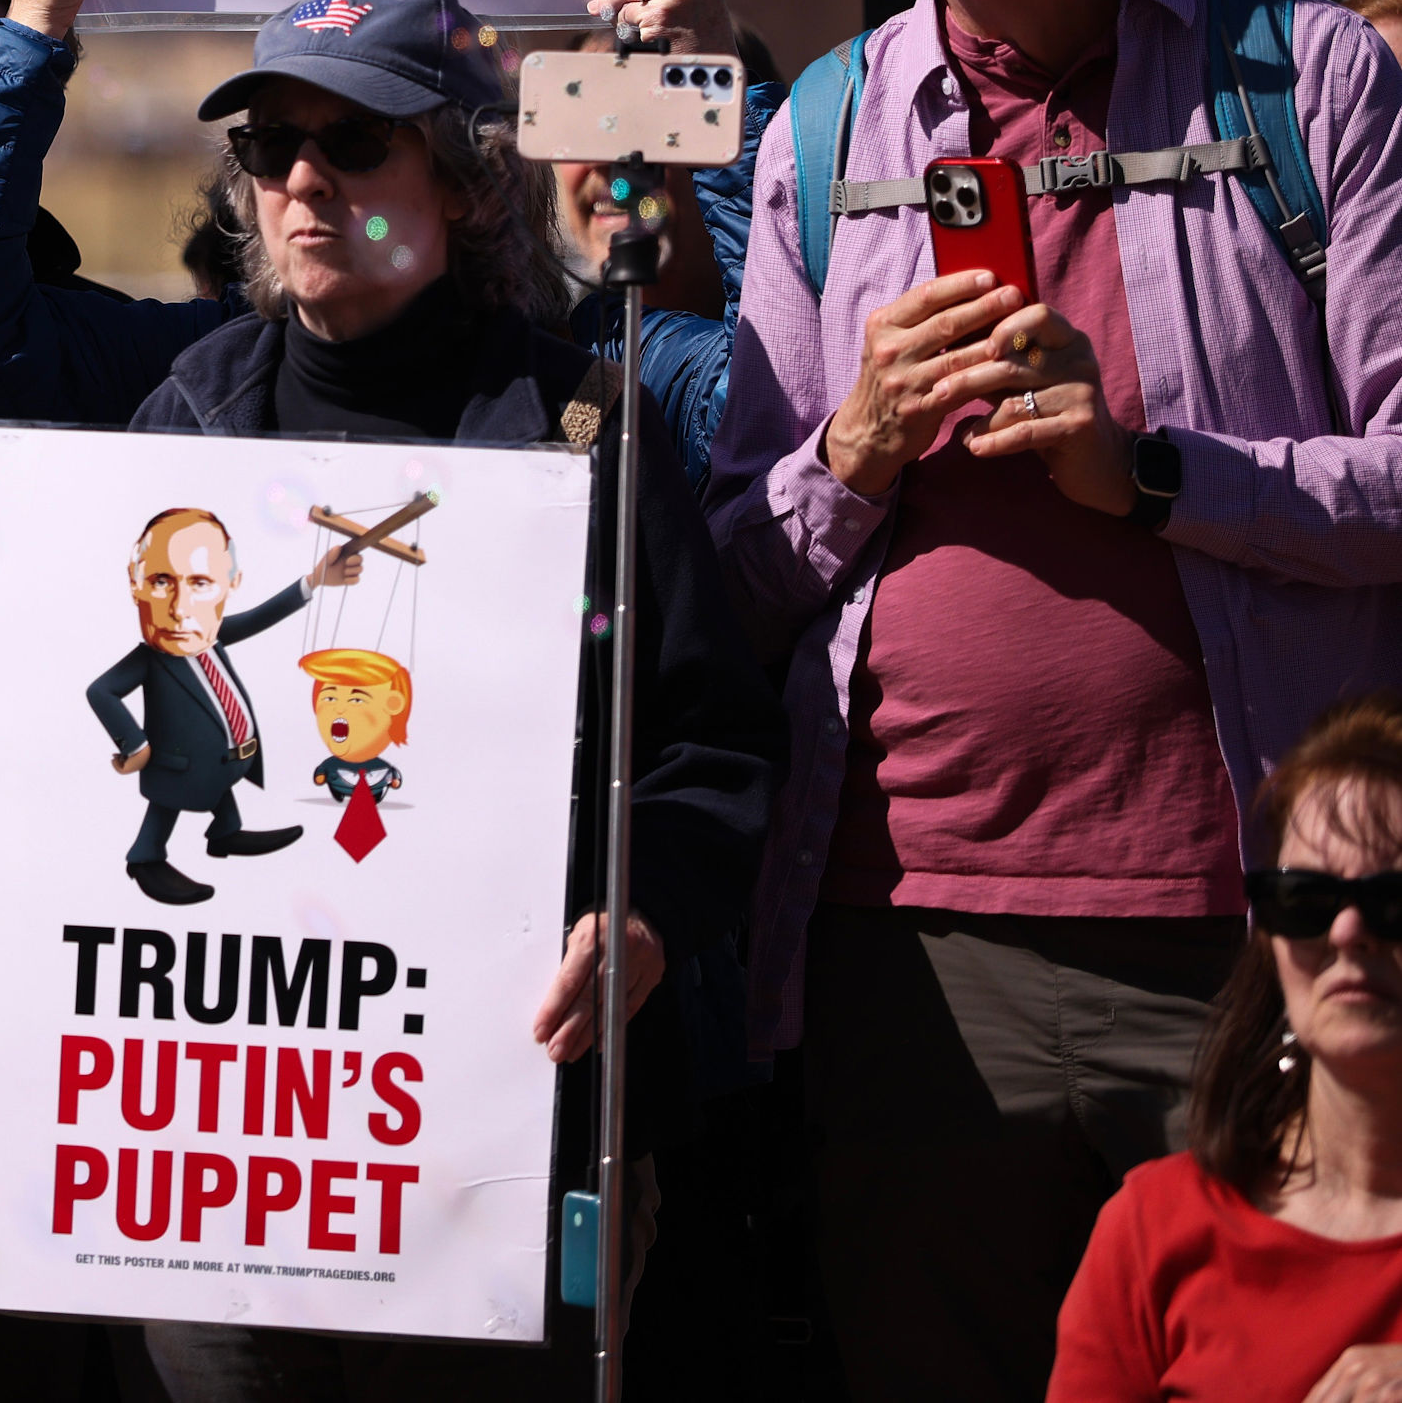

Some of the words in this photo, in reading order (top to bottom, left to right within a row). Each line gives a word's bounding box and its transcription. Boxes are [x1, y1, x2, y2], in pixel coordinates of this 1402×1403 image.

[63, 924, 428, 1036] TRUMP:
[58, 1034, 424, 1147] PUTIN'S
[52, 1144, 420, 1255] PUPPET
[75, 1253, 96, 1265] GET
[98, 1254, 122, 1266] THIS
[124, 1256, 165, 1269] POSTER
[167, 1259, 190, 1271] AND
[192, 1260, 224, 1273] MORE
[226, 1262, 241, 1274] AT
[243, 1263, 396, 1284] WWW.TRUMPTRAGEDIES.ORG
